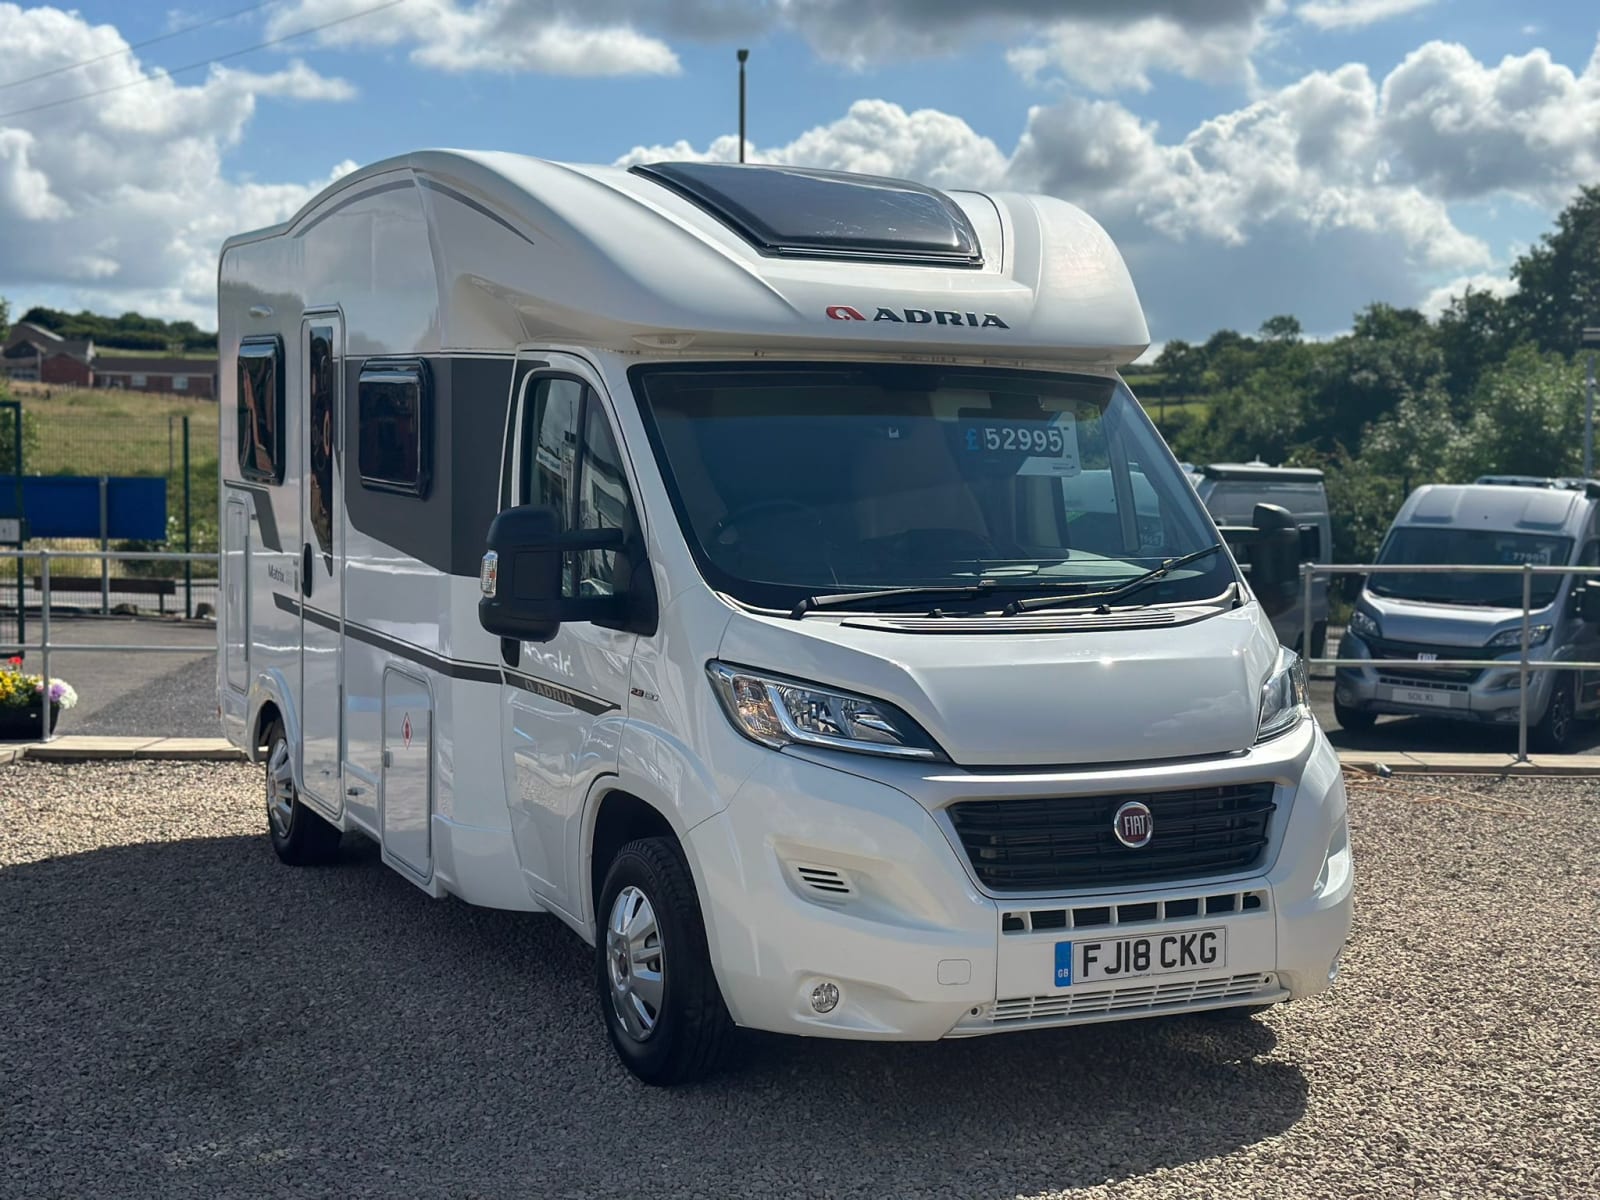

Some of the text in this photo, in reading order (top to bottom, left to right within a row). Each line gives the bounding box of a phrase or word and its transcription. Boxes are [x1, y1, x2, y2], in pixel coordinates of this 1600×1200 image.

[873, 307, 1010, 329] ADRIA
[1123, 814, 1146, 836] FIAT
[1082, 932, 1217, 978] FJ18 CKG
[1057, 968, 1069, 978] GB
